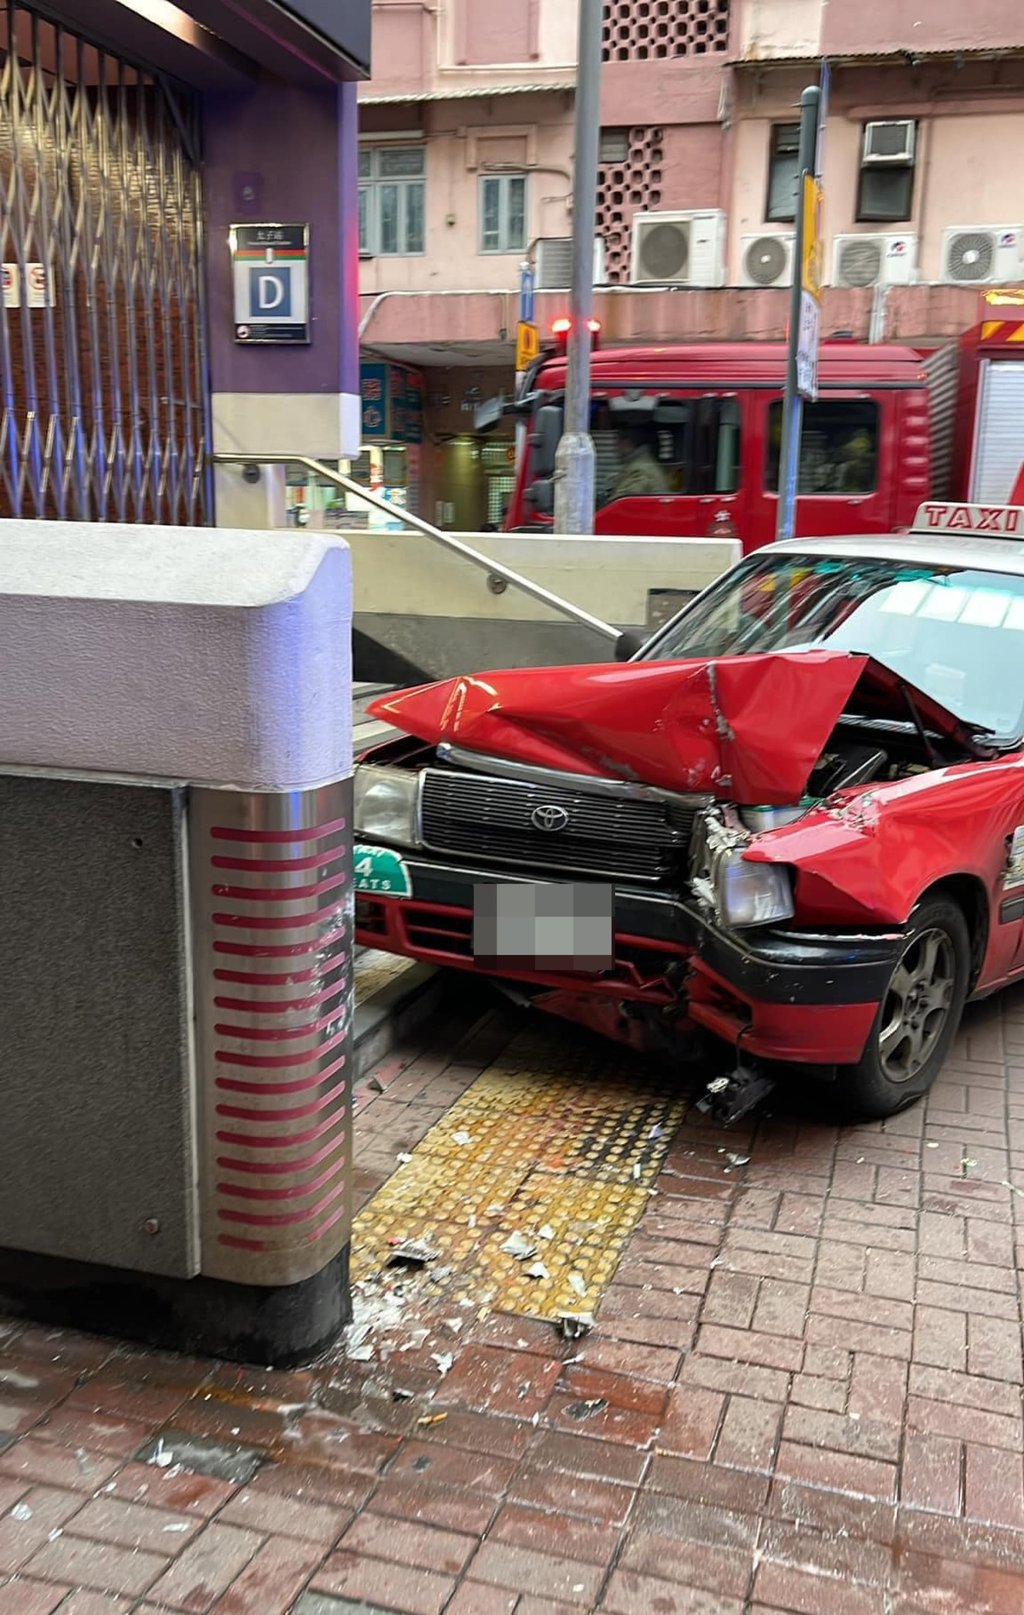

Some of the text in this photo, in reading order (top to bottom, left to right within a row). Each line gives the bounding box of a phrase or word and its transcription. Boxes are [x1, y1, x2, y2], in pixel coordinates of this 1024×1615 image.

[258, 275, 283, 309] D
[925, 505, 1019, 531] TAXI
[354, 856, 373, 876] 4
